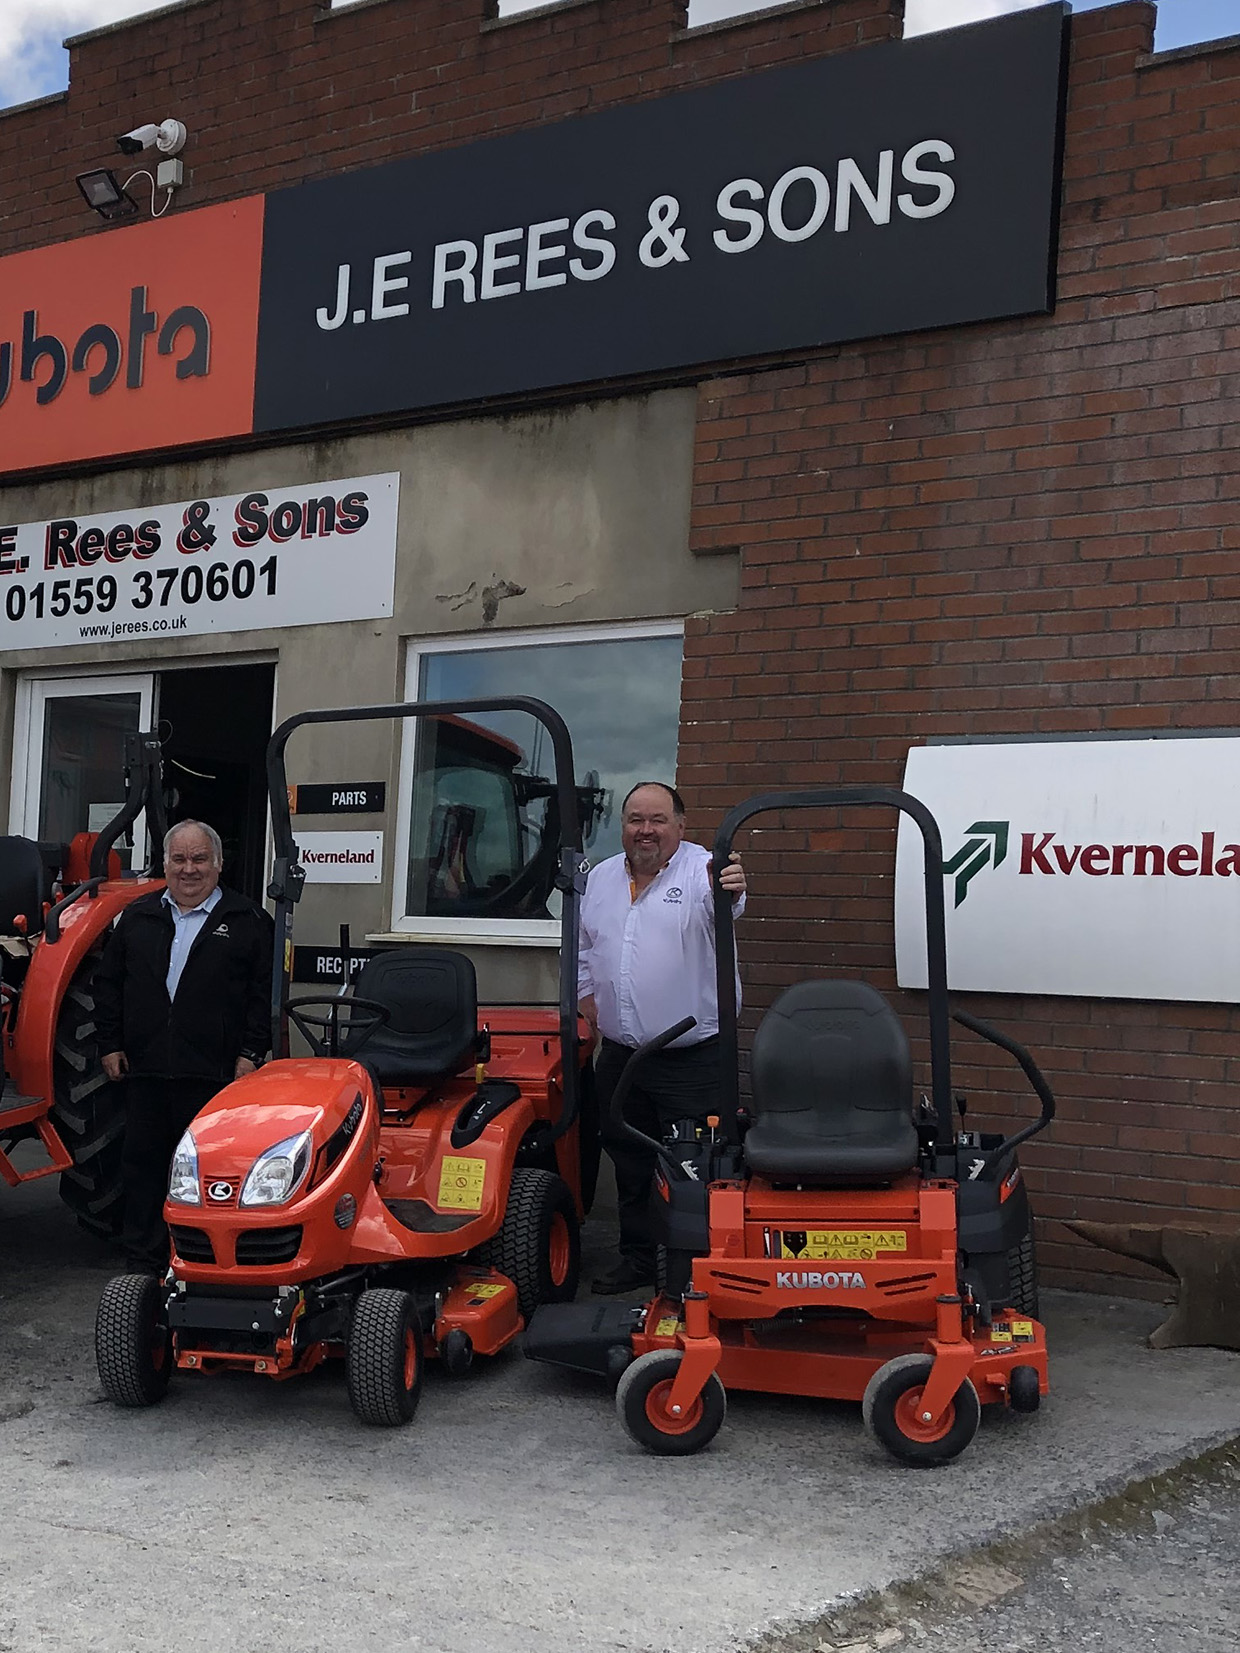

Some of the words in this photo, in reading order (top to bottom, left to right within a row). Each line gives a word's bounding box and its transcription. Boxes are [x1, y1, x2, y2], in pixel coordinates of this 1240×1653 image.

[316, 250, 412, 331] J.E
[431, 209, 616, 309] REES
[638, 194, 691, 268] &
[711, 139, 956, 255] SONS
[44, 519, 162, 571] Rees
[176, 500, 217, 554] &
[232, 491, 370, 548] Sons
[6, 574, 118, 622] 01559
[131, 555, 278, 612] 370601
[79, 614, 188, 638] www.jerees.co.uk
[332, 791, 367, 806] PARTS
[302, 849, 374, 864] Kverneland
[316, 956, 370, 974] RECPT
[776, 1272, 867, 1289] KUBOTA
